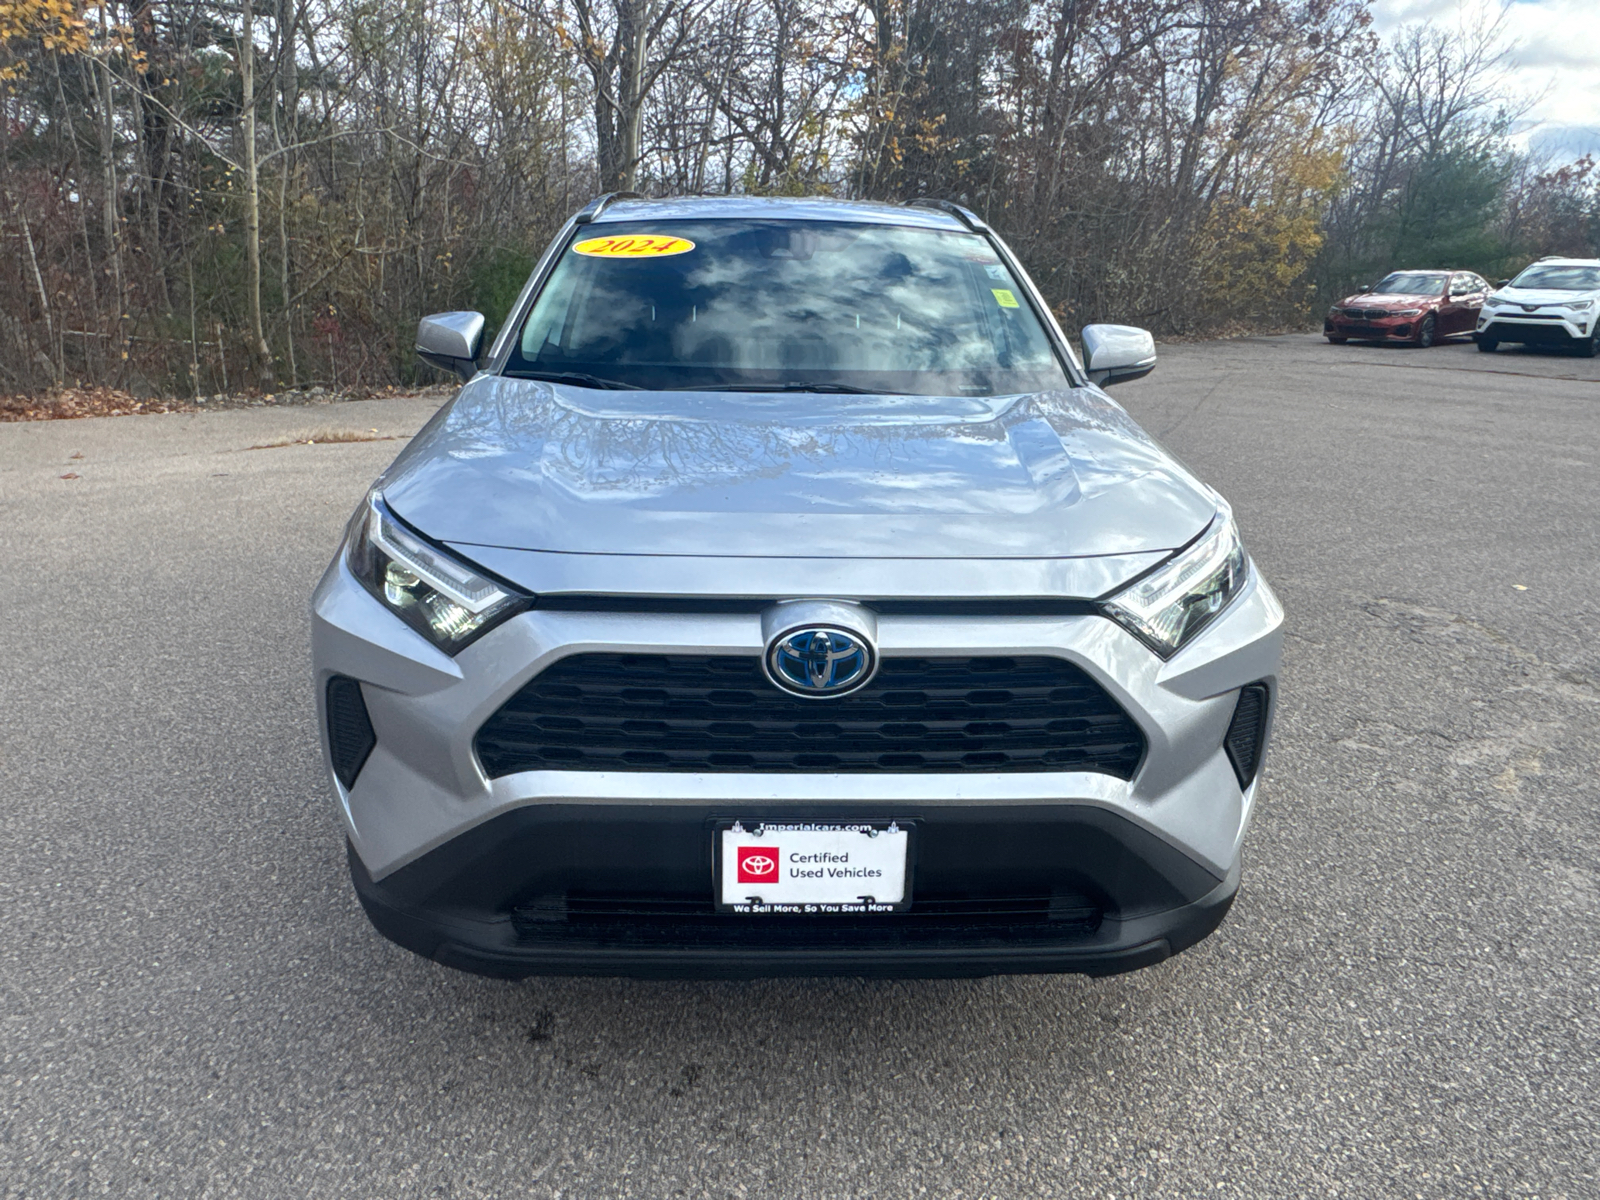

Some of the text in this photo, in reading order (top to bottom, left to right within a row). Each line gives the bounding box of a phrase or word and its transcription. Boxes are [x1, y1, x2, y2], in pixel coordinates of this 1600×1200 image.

[588, 239, 680, 253] 2024
[789, 852, 849, 863] Certified
[789, 867, 882, 878] Used Vehicles
[733, 904, 893, 914] We Sell More, So You Save More
